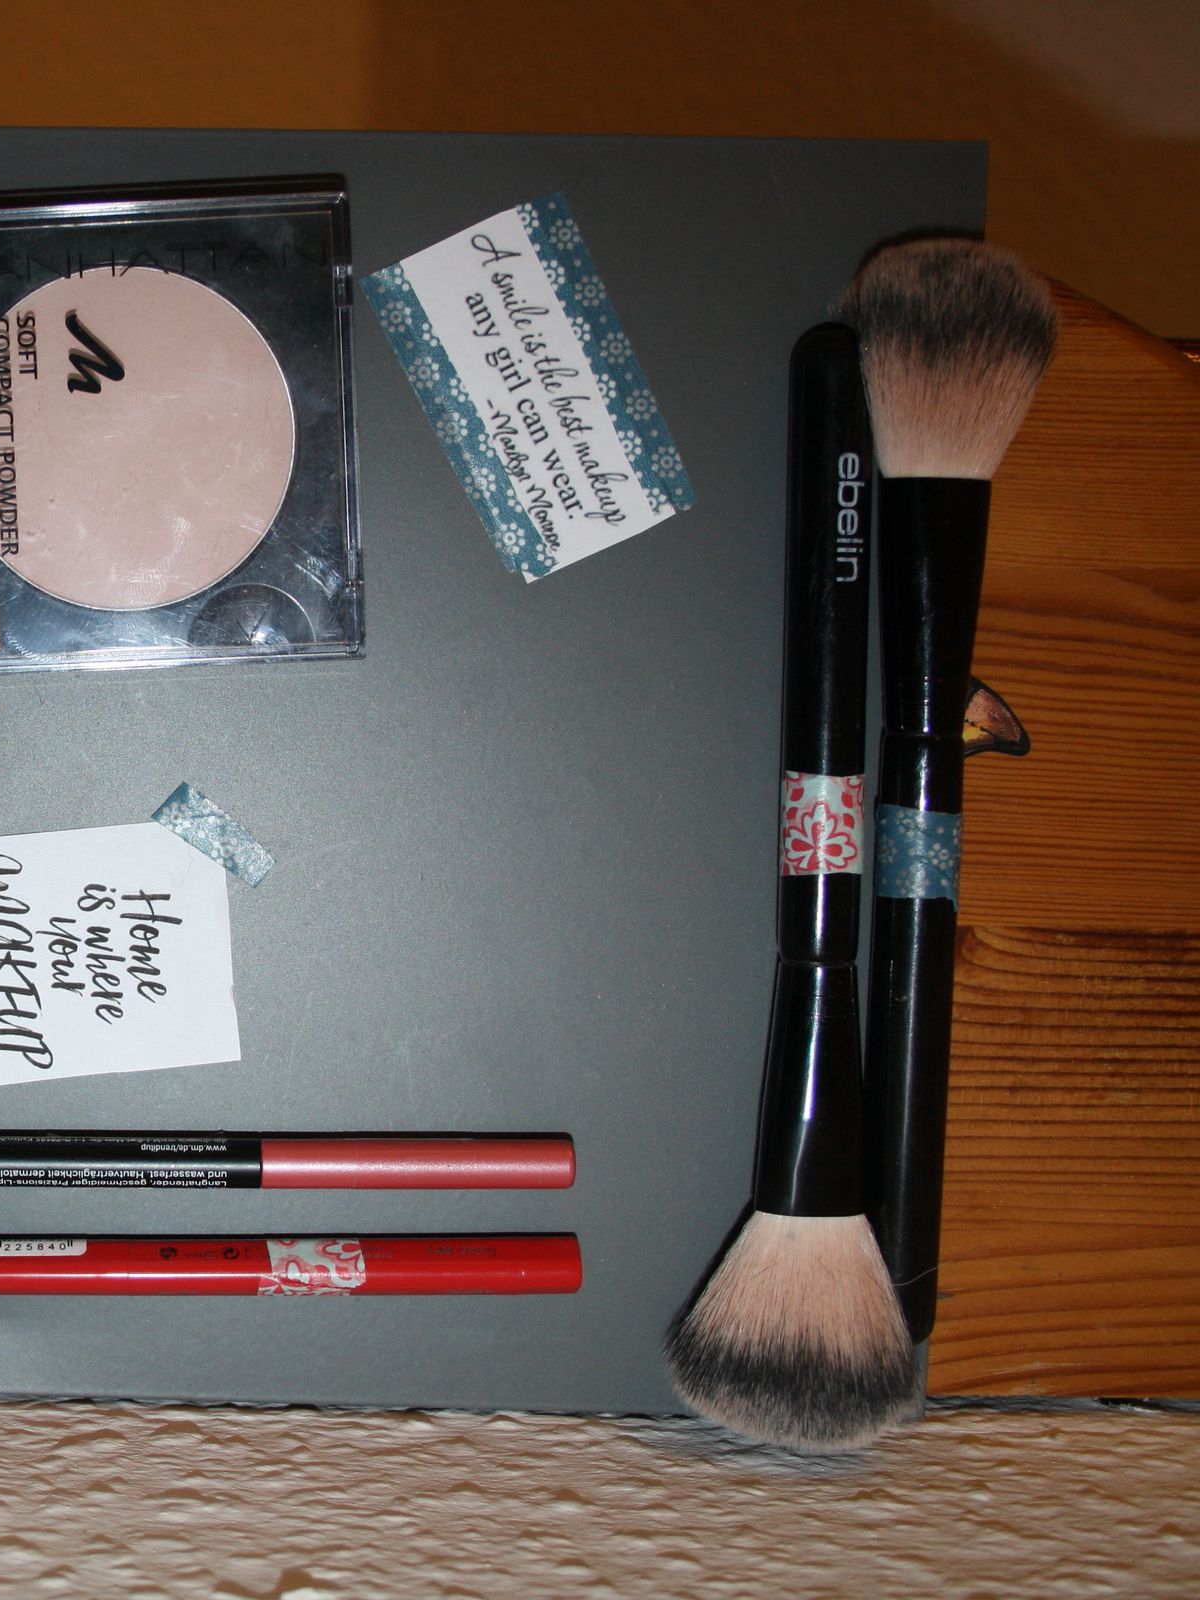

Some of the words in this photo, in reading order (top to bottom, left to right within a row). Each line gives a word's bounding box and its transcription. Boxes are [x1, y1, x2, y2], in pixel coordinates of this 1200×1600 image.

[470, 234, 521, 267] A
[491, 273, 548, 330] smile
[17, 311, 38, 380] SOFT
[521, 332, 551, 355] is
[531, 356, 579, 393] the
[464, 292, 500, 337] any
[484, 347, 531, 392] girl
[516, 399, 549, 446] can
[540, 448, 586, 521] wear.
[549, 396, 593, 440] best
[575, 441, 630, 527] makeup
[525, 485, 562, 552] Monroe
[836, 453, 864, 582] ebelin
[77, 884, 117, 913] is
[37, 916, 85, 995] your
[121, 890, 183, 1003] Home
[85, 926, 127, 1024] where
[141, 1143, 226, 1152] www.dm.de/trenditup
[48, 1168, 144, 1179] Hautverträglichkeit
[147, 1170, 204, 1178] wasserfest.
[150, 1179, 226, 1187] Langhaftender,
[207, 1170, 227, 1178] und
